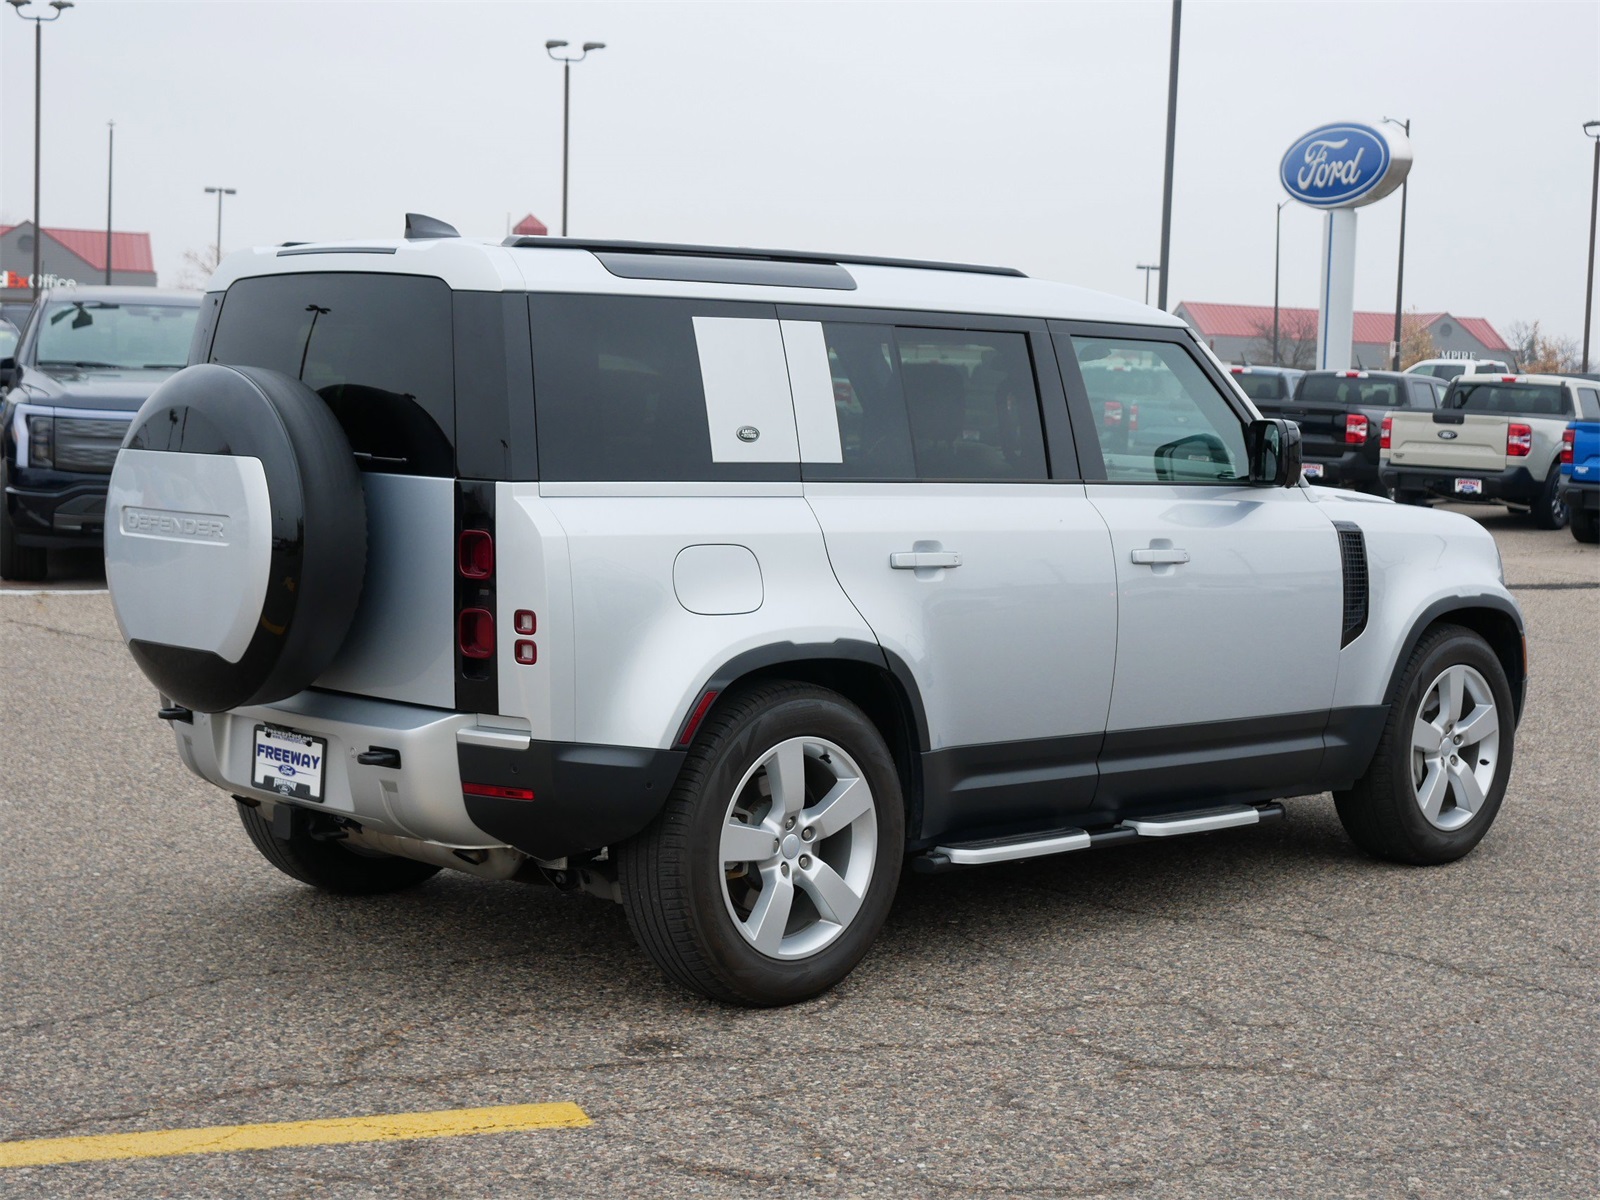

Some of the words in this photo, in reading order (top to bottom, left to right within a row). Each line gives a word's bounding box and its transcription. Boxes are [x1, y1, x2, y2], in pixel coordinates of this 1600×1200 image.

[1297, 138, 1364, 190] Ford
[28, 273, 77, 289] Office
[127, 512, 224, 537] DEFENDER
[257, 743, 320, 769] FREEWAY
